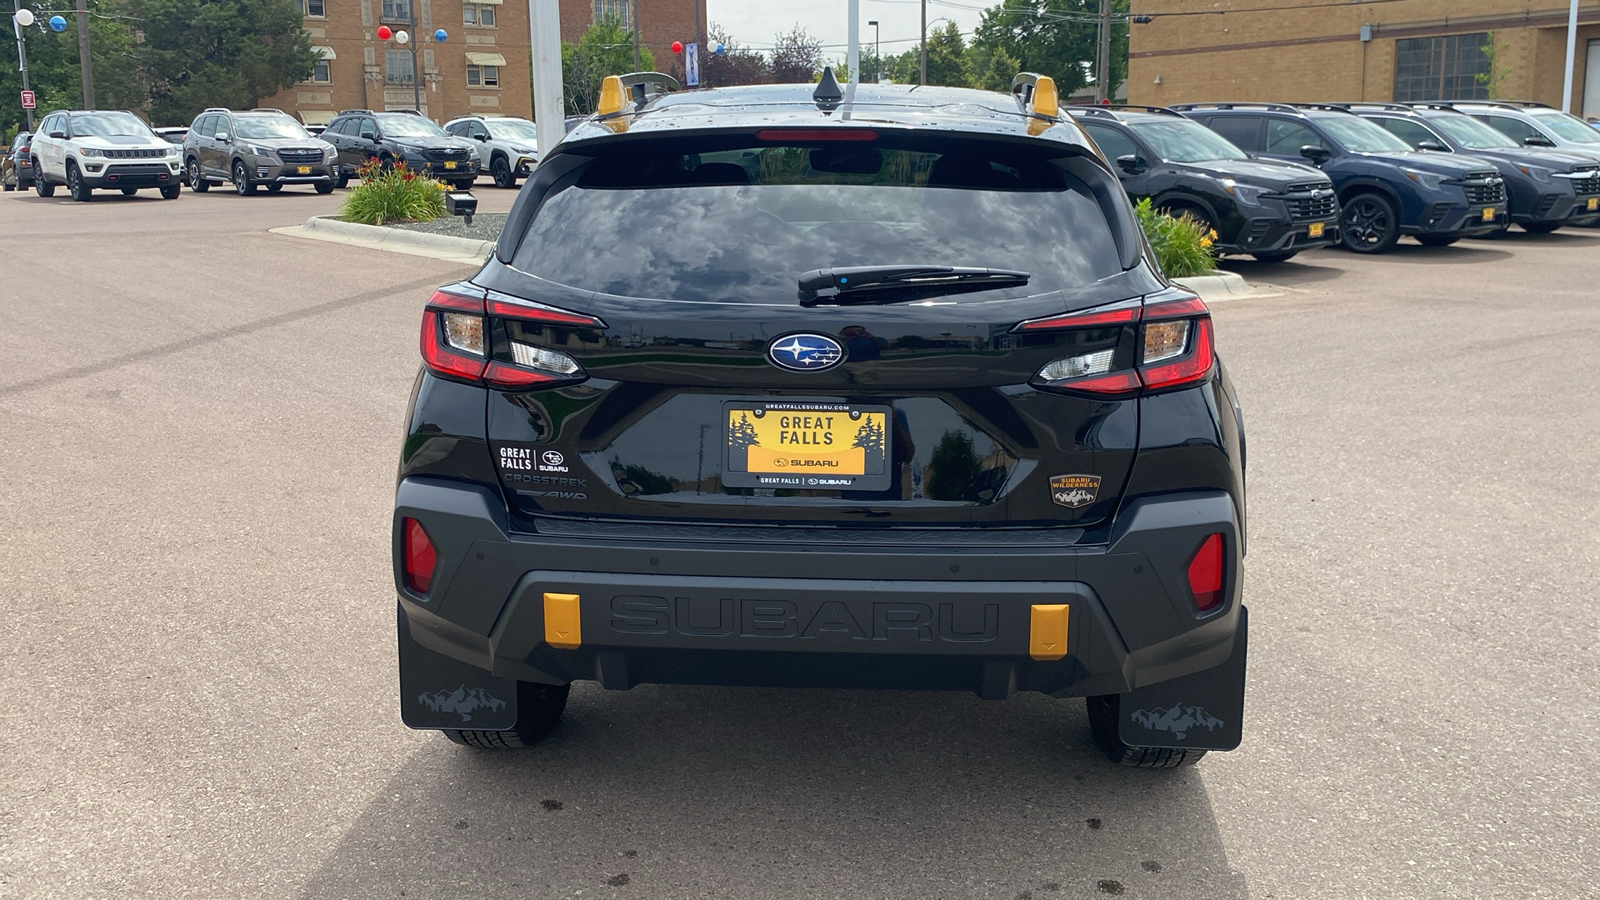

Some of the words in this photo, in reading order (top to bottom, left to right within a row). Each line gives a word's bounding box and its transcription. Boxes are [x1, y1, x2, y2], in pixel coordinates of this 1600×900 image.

[765, 403, 850, 411] GREATFALLSSUBARU.COM
[780, 416, 834, 429] GREAT
[780, 431, 834, 445] FALLS
[500, 447, 531, 459] GREAT
[501, 458, 532, 470] FALLS
[539, 465, 569, 473] SUBARU
[790, 459, 839, 467] SUBARU
[504, 473, 588, 488] CROSSTREK
[543, 491, 588, 500] AWD
[609, 594, 1000, 643] SUBARU
